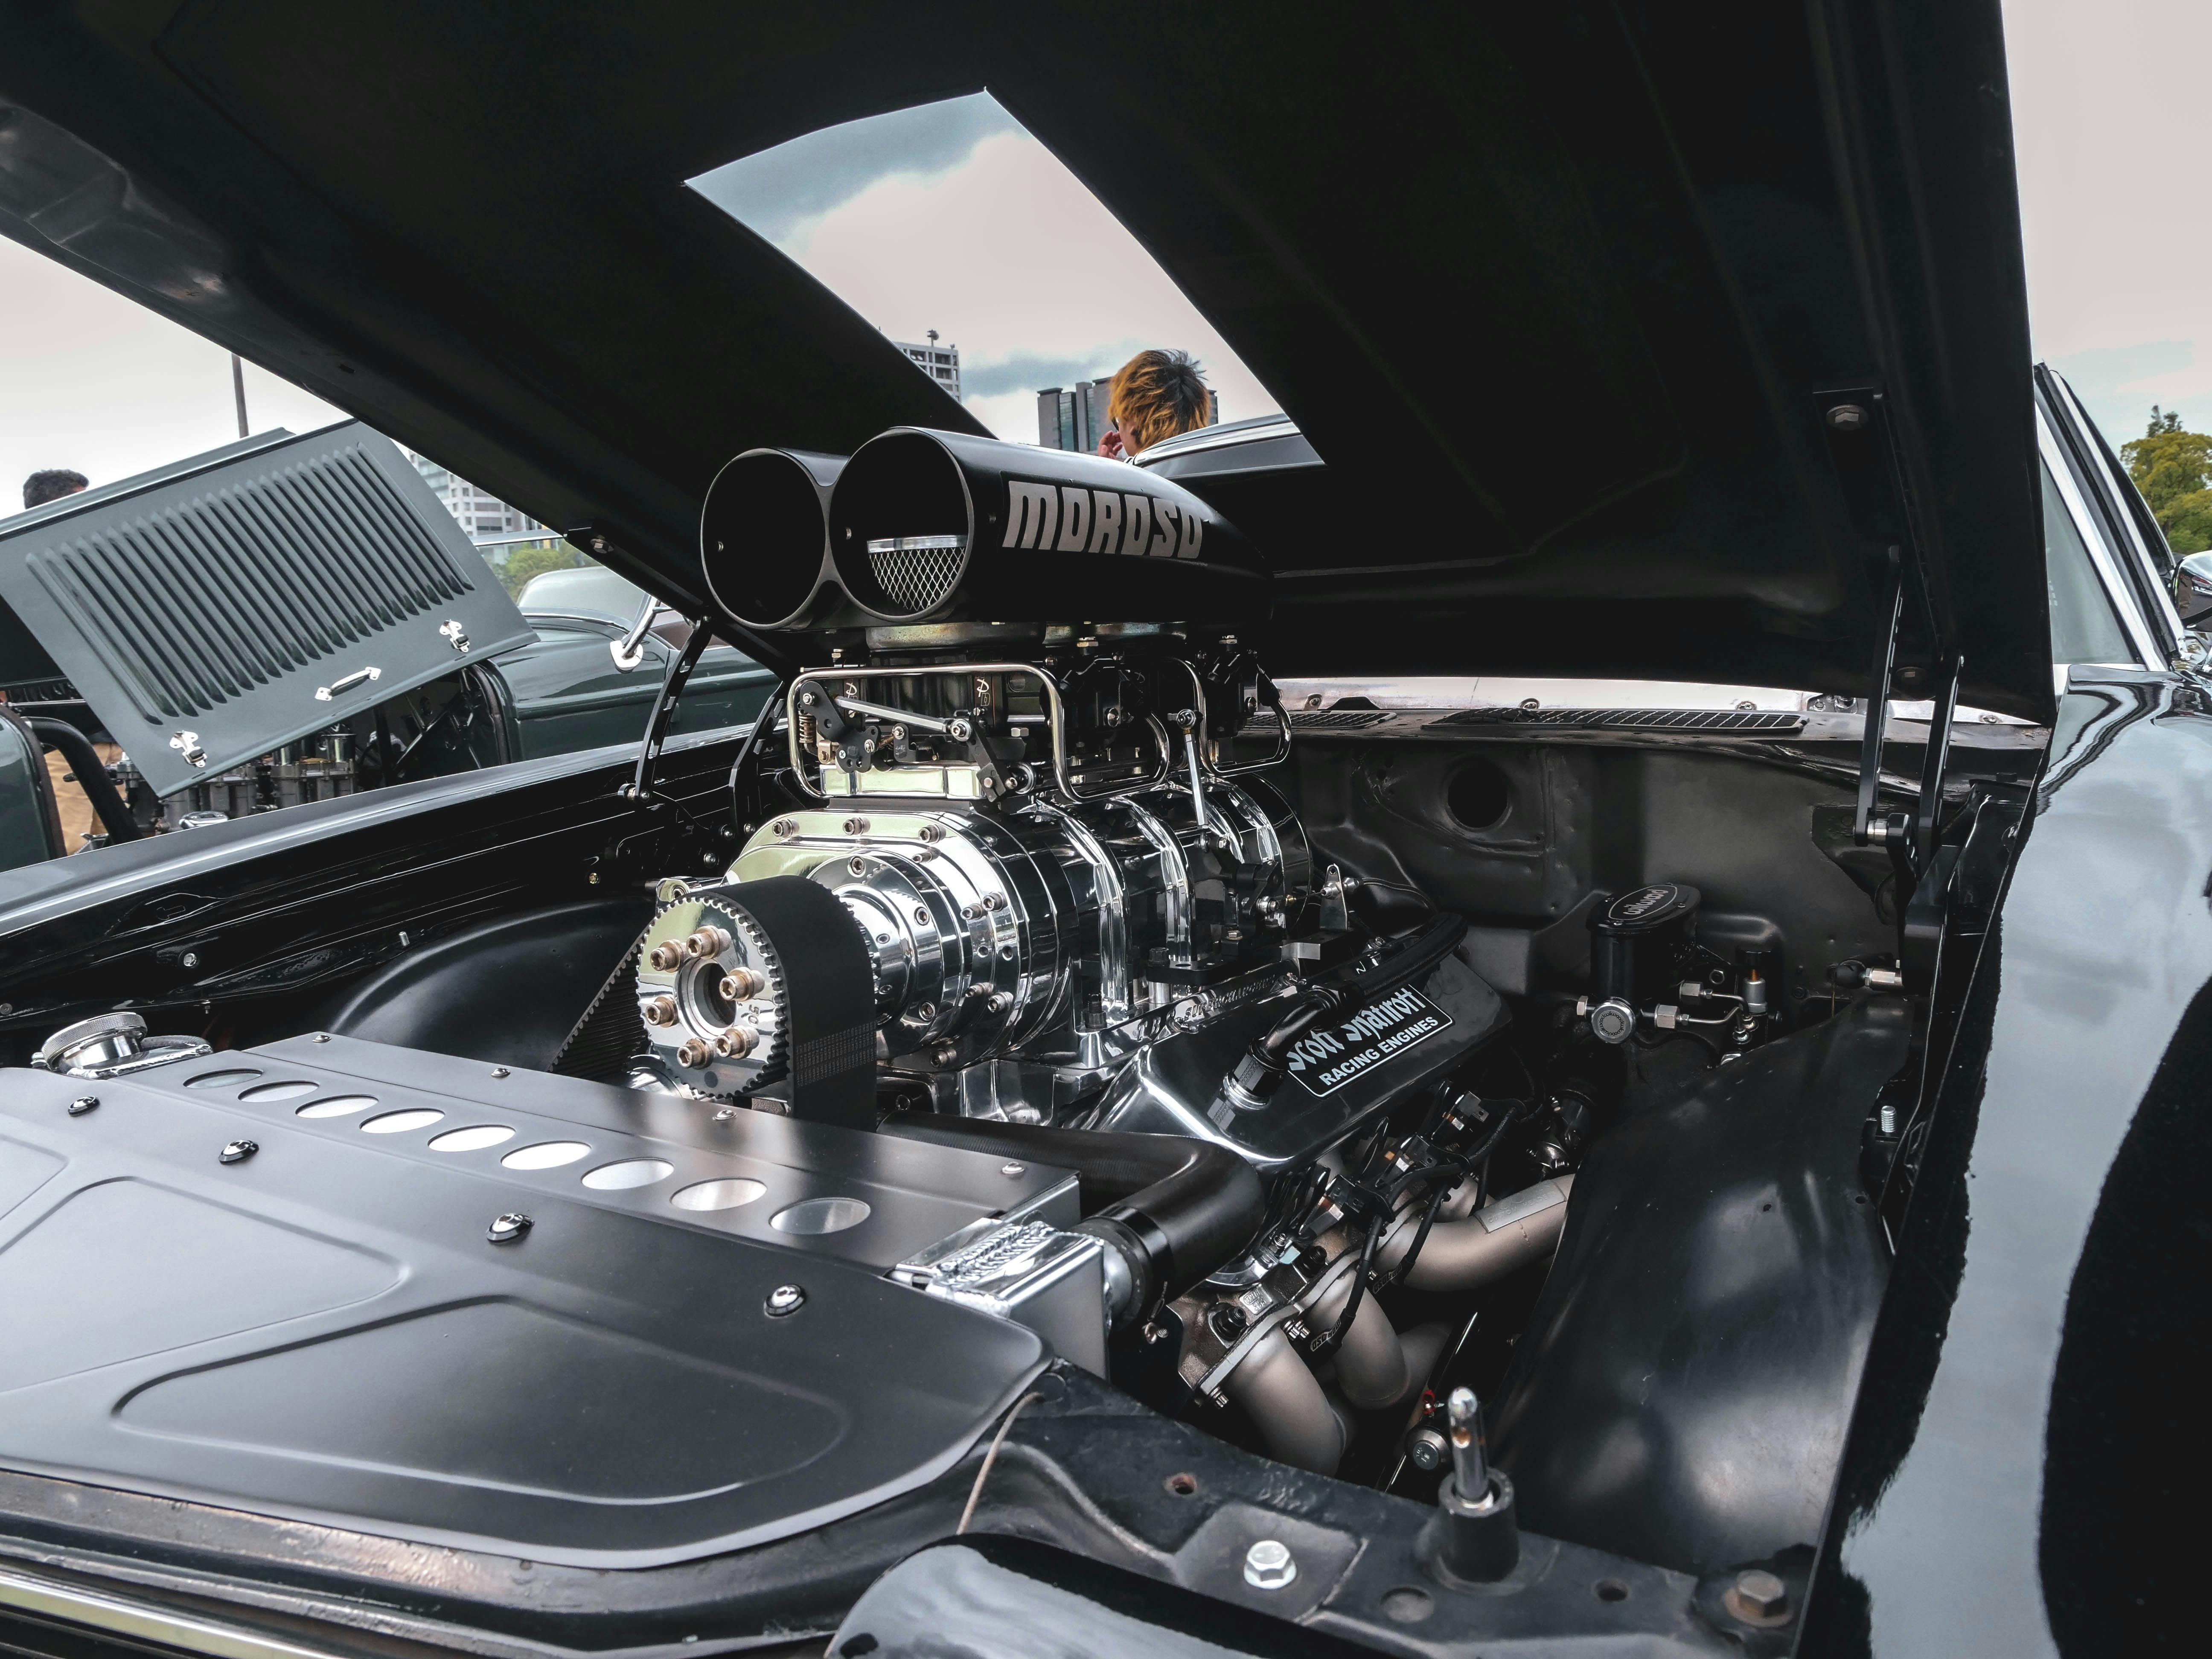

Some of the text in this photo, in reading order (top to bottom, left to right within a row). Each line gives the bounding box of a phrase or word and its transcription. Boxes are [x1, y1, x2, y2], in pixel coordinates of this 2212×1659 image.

[1002, 480, 1202, 559] MOROSO
[1623, 889, 1669, 915] wilwood
[1318, 1016, 1438, 1086] RACING ENGINES
